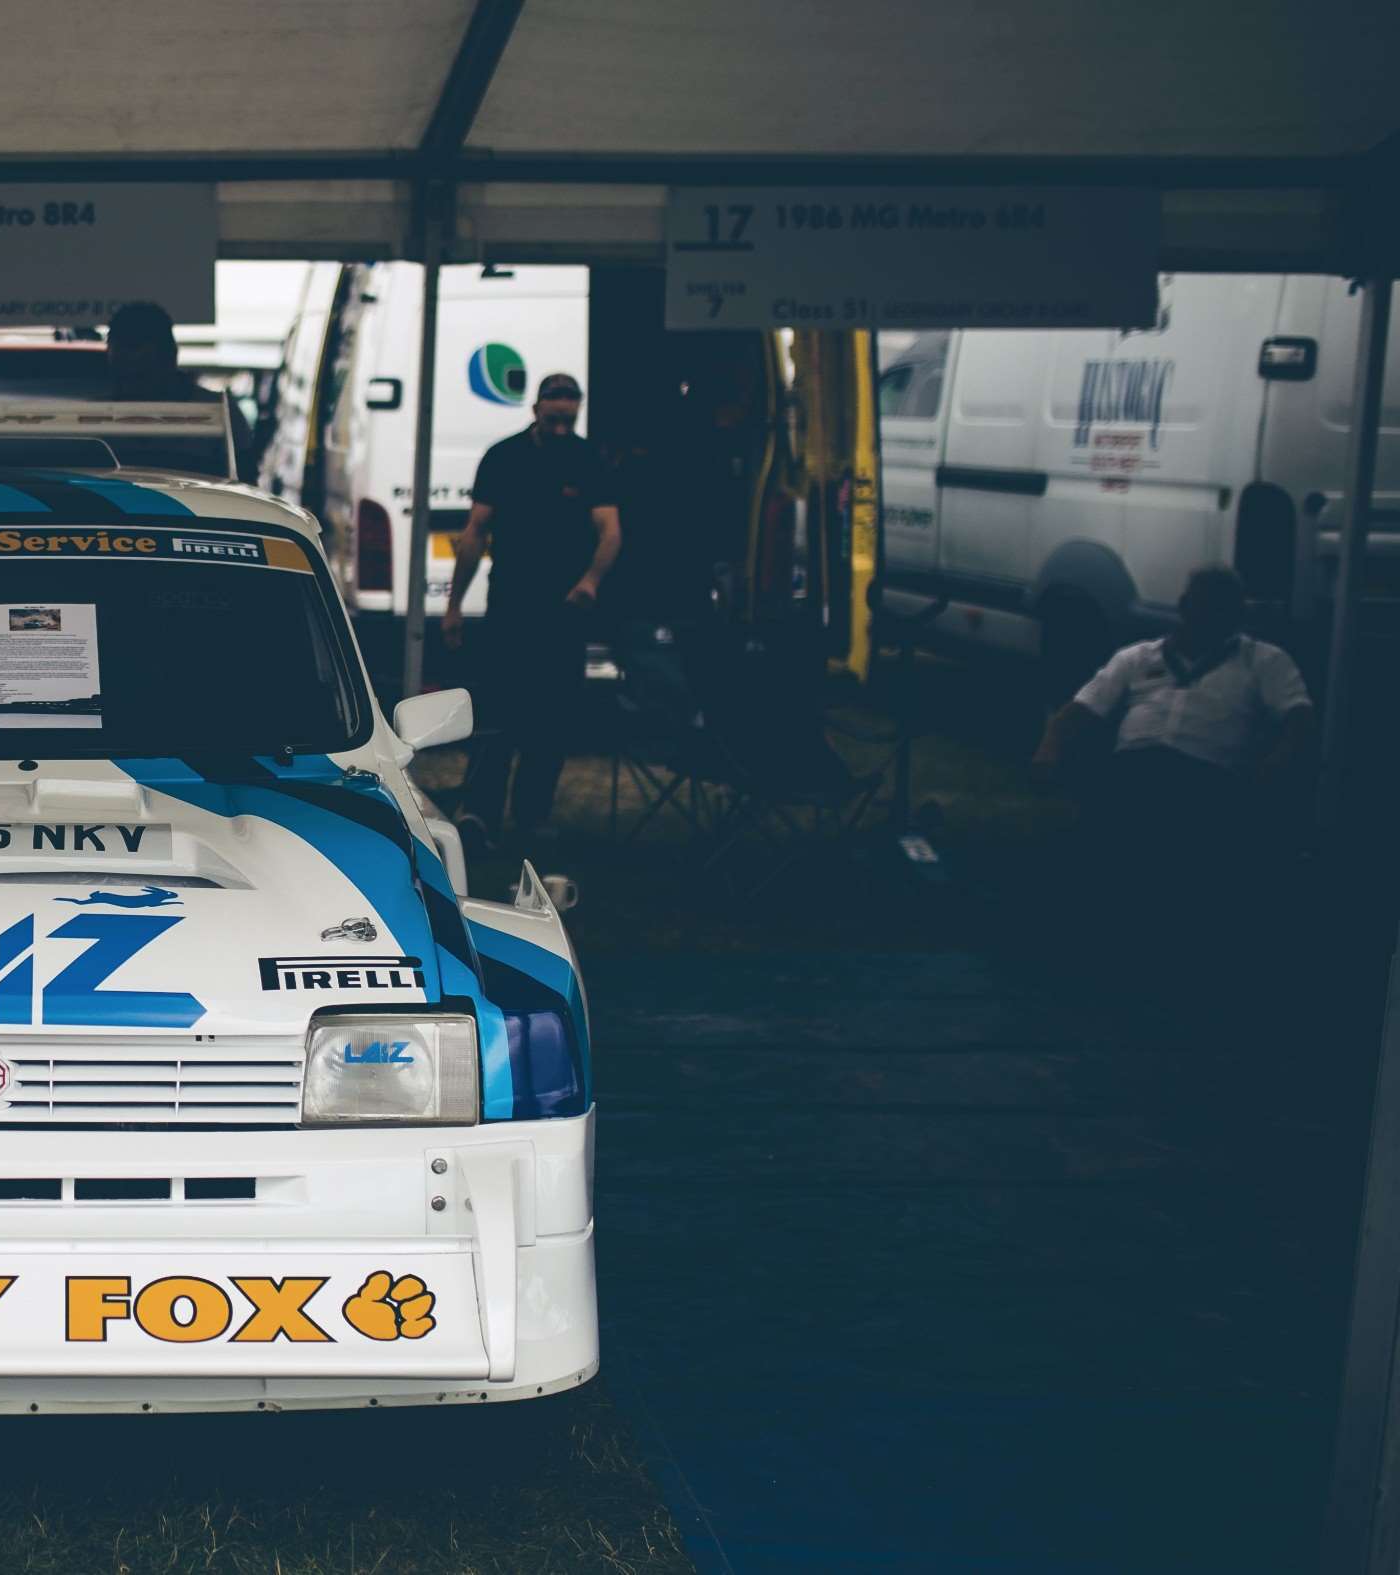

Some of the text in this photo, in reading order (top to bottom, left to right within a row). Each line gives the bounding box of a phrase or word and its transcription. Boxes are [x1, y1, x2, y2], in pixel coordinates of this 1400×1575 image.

[703, 203, 756, 242] 17
[850, 202, 899, 230] MG
[906, 202, 987, 230] Metro
[708, 296, 725, 319] 7
[770, 297, 833, 320] Class
[172, 537, 260, 558] PIRELLI
[32, 824, 147, 853] NKV
[257, 956, 427, 991] PIRELLI
[65, 1275, 339, 1344] FOX
